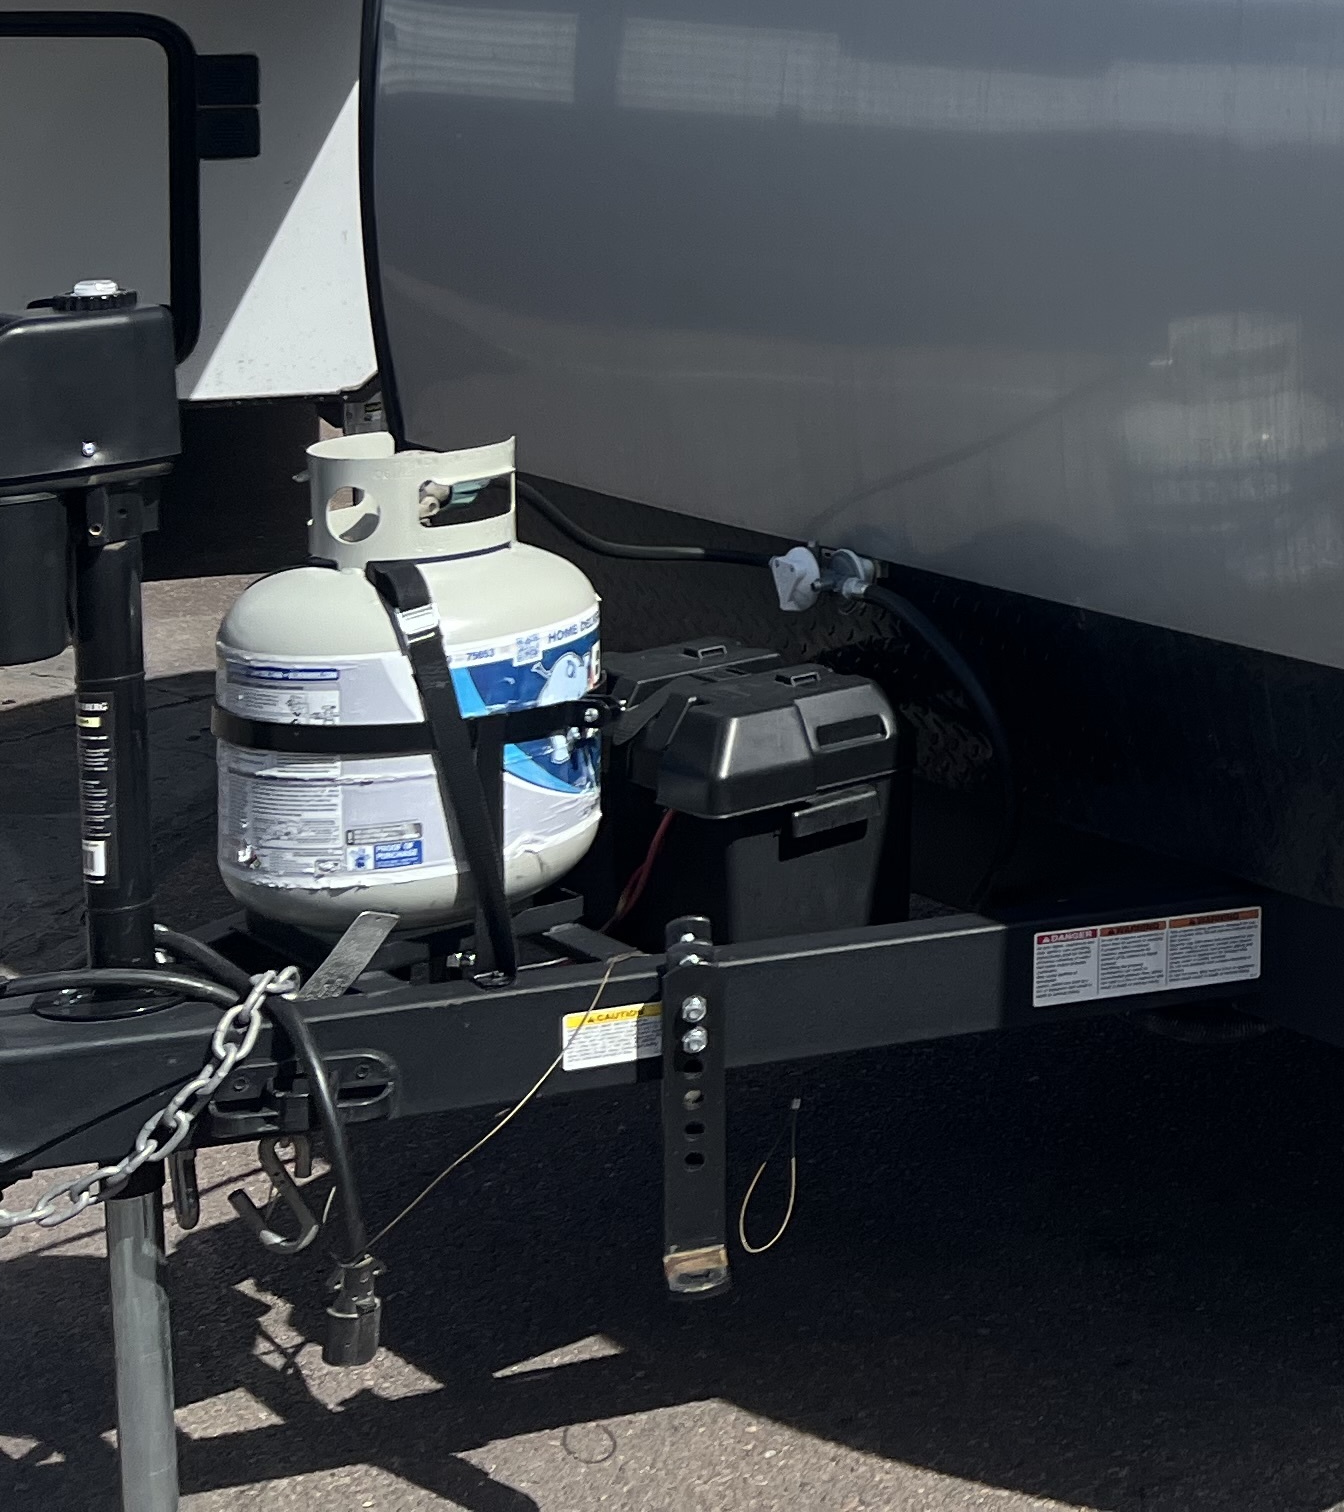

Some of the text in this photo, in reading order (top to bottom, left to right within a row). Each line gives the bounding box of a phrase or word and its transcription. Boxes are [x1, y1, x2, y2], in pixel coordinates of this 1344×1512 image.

[548, 625, 579, 643] HOME
[1051, 929, 1093, 943] DANGER
[596, 1007, 645, 1023] CAUTION
